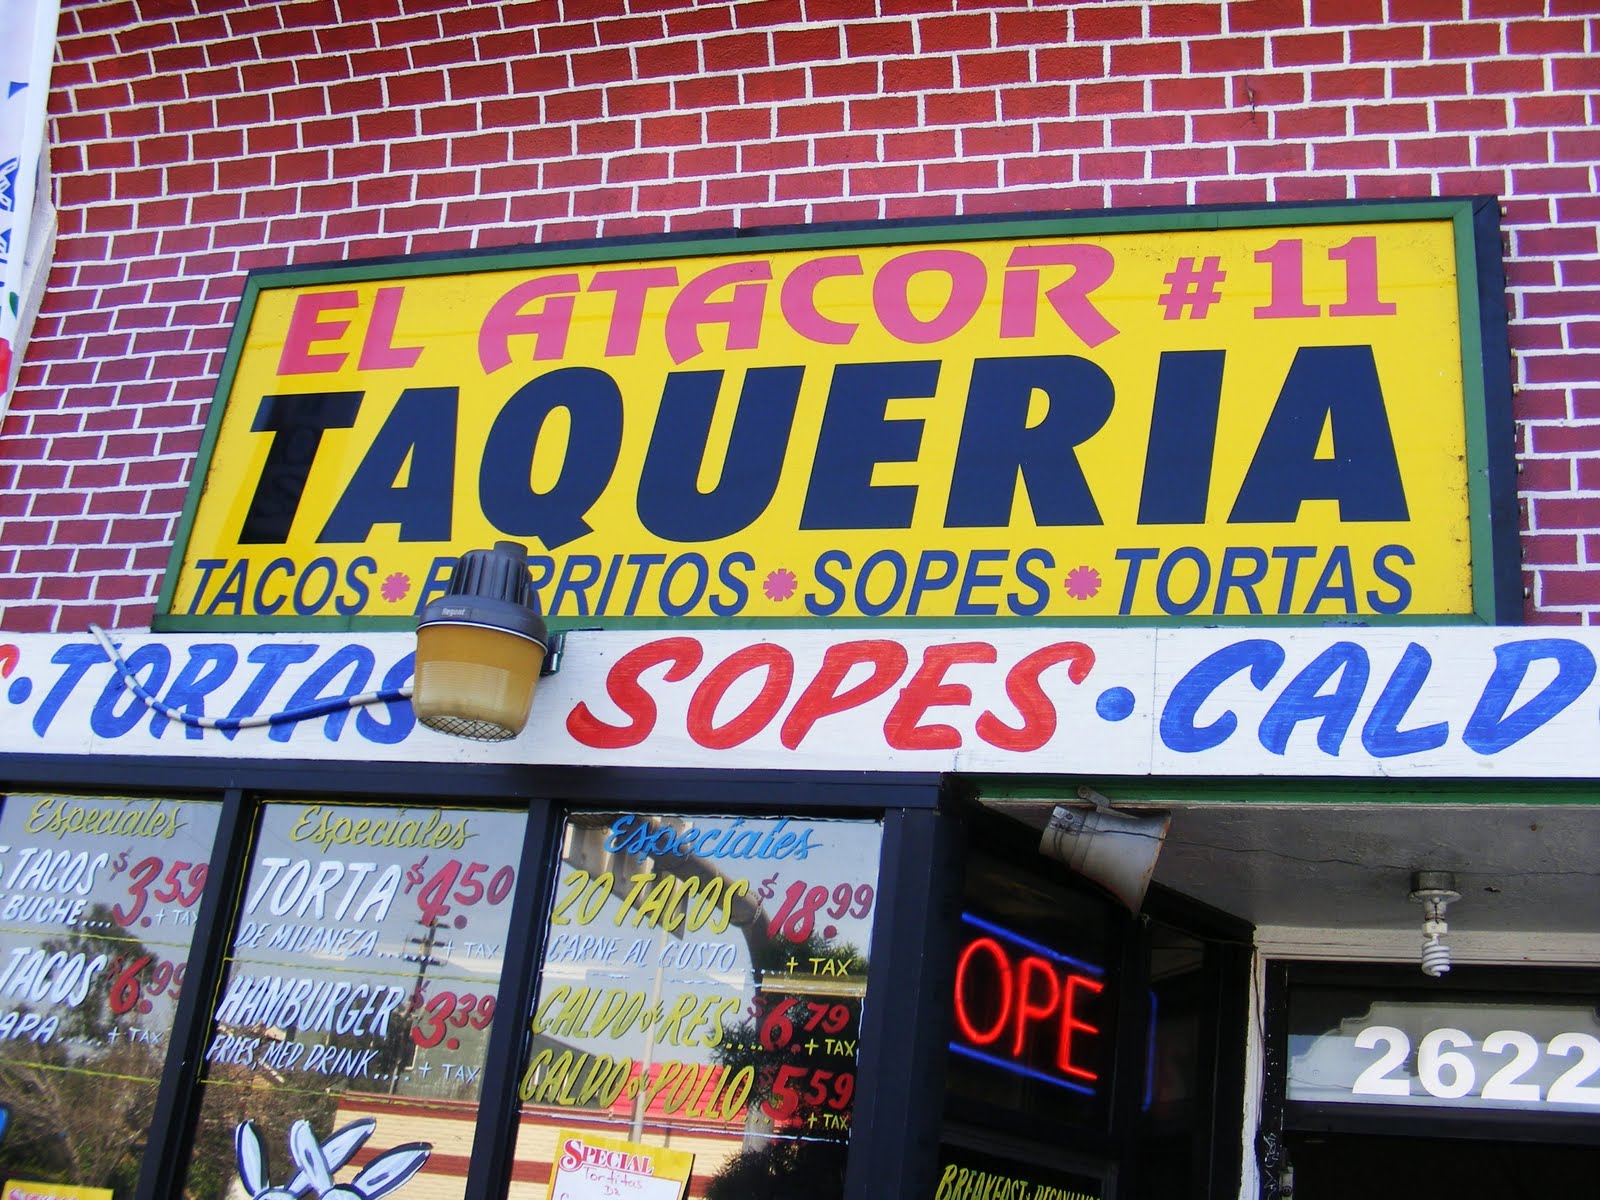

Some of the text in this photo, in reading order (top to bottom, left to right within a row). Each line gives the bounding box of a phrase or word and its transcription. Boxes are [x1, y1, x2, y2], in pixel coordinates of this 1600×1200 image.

[276, 286, 424, 376] EL
[478, 242, 1120, 375] ATACOR
[237, 344, 1411, 551] TAQUERIA
[187, 556, 378, 616] TACOS
[804, 547, 1057, 617] SOPES
[1113, 544, 1416, 617] TORTAS
[33, 636, 1600, 758] TORTAS SOPES CALD
[25, 798, 189, 840] Especiales
[289, 805, 480, 853] Especiales
[605, 814, 824, 864] Especiales
[6, 847, 110, 895] TACOS
[246, 855, 516, 930] TORTA $4.50
[551, 869, 875, 945] 20 TACOS $18.99
[233, 921, 272, 949] DE
[464, 941, 500, 959] TAX
[546, 933, 626, 964] CARNE
[621, 938, 653, 967] AL
[808, 958, 853, 977] TAX
[0, 946, 108, 1008] TACOS
[129, 1027, 162, 1045] TAX
[214, 974, 407, 1041] HAMBURGER
[532, 983, 648, 1040] CALDO
[953, 935, 1105, 1082] OPE
[442, 1063, 482, 1084] TAX
[824, 1038, 856, 1057] TAX
[1352, 1025, 1600, 1105] 2622
[519, 1048, 635, 1109] CALDO
[823, 1113, 848, 1130] TAX
